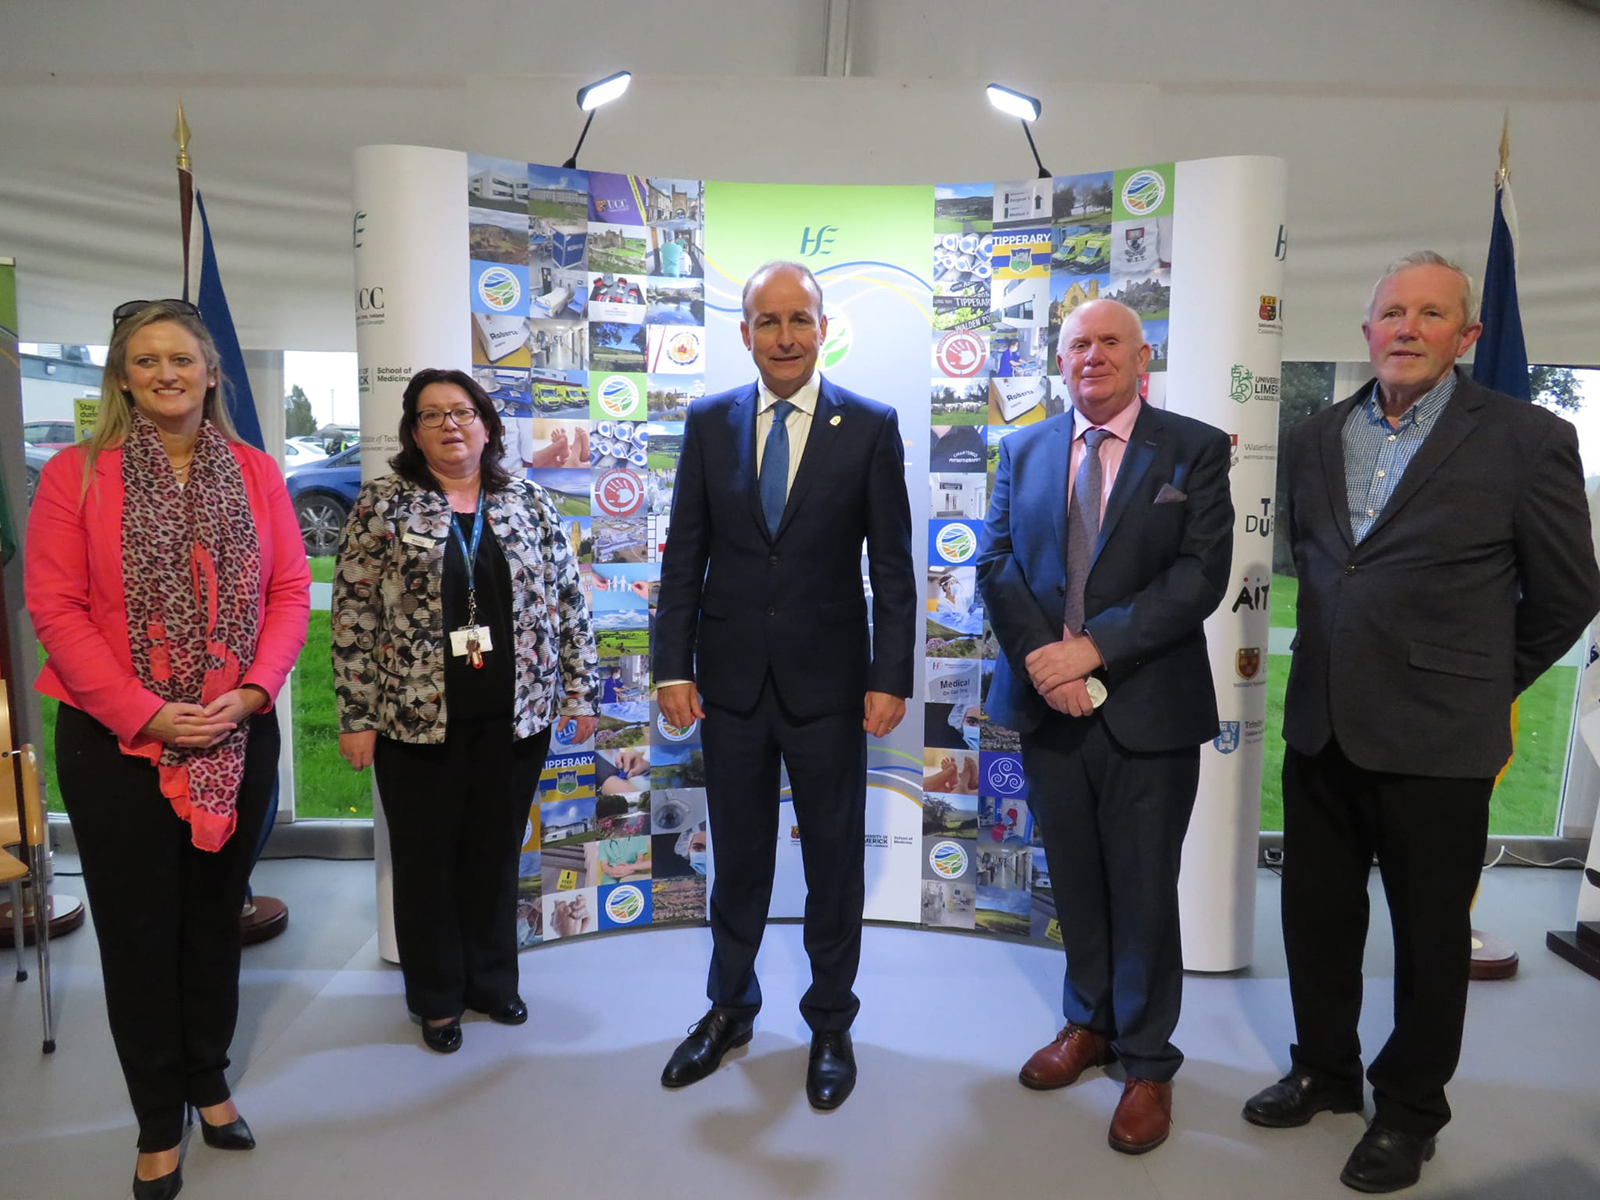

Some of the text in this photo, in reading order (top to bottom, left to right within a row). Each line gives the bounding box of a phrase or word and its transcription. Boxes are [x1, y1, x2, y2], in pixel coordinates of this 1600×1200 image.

[993, 233, 1052, 245] TIPPERARY
[355, 287, 384, 310] CC
[940, 678, 971, 689] Medical
[543, 755, 595, 770] IPPERARY
